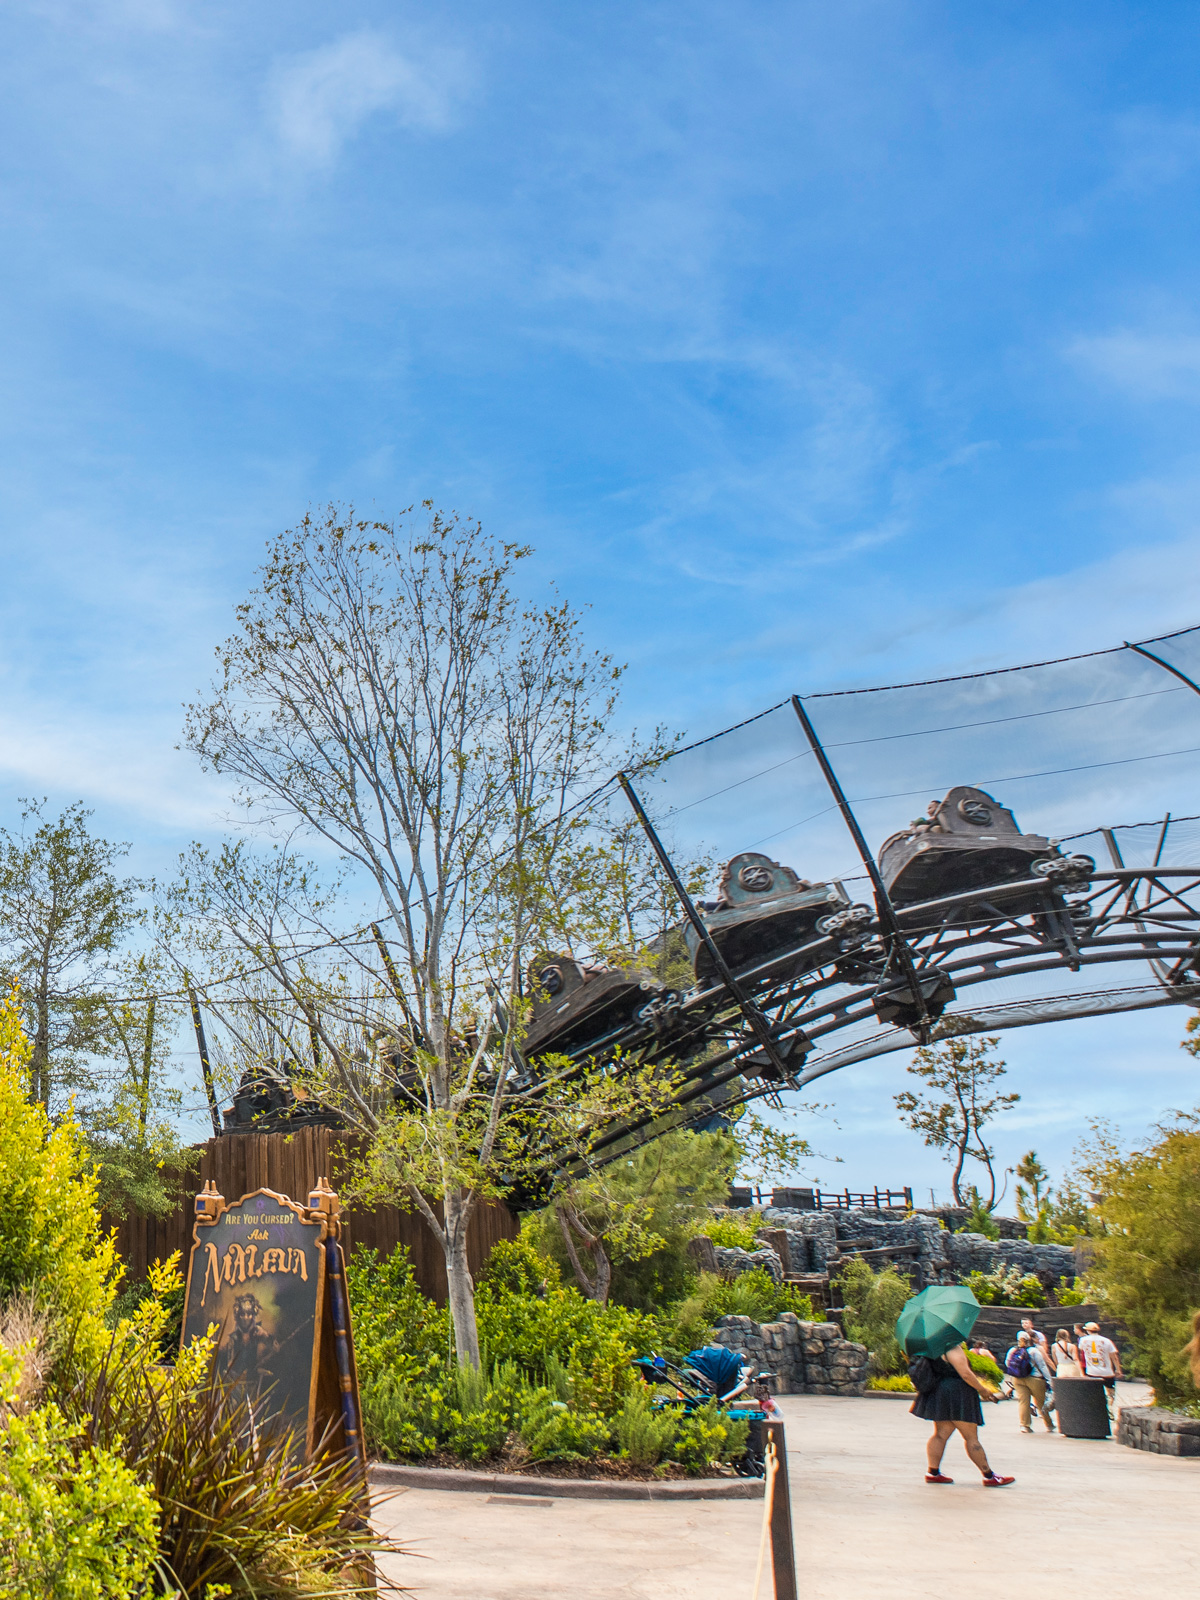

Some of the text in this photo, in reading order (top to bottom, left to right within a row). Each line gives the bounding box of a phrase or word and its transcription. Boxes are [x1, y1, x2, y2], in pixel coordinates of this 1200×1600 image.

[225, 1213, 294, 1225] ARE YOU CURSED?
[247, 1229, 269, 1240] Ask
[201, 1242, 308, 1308] MALEVA
